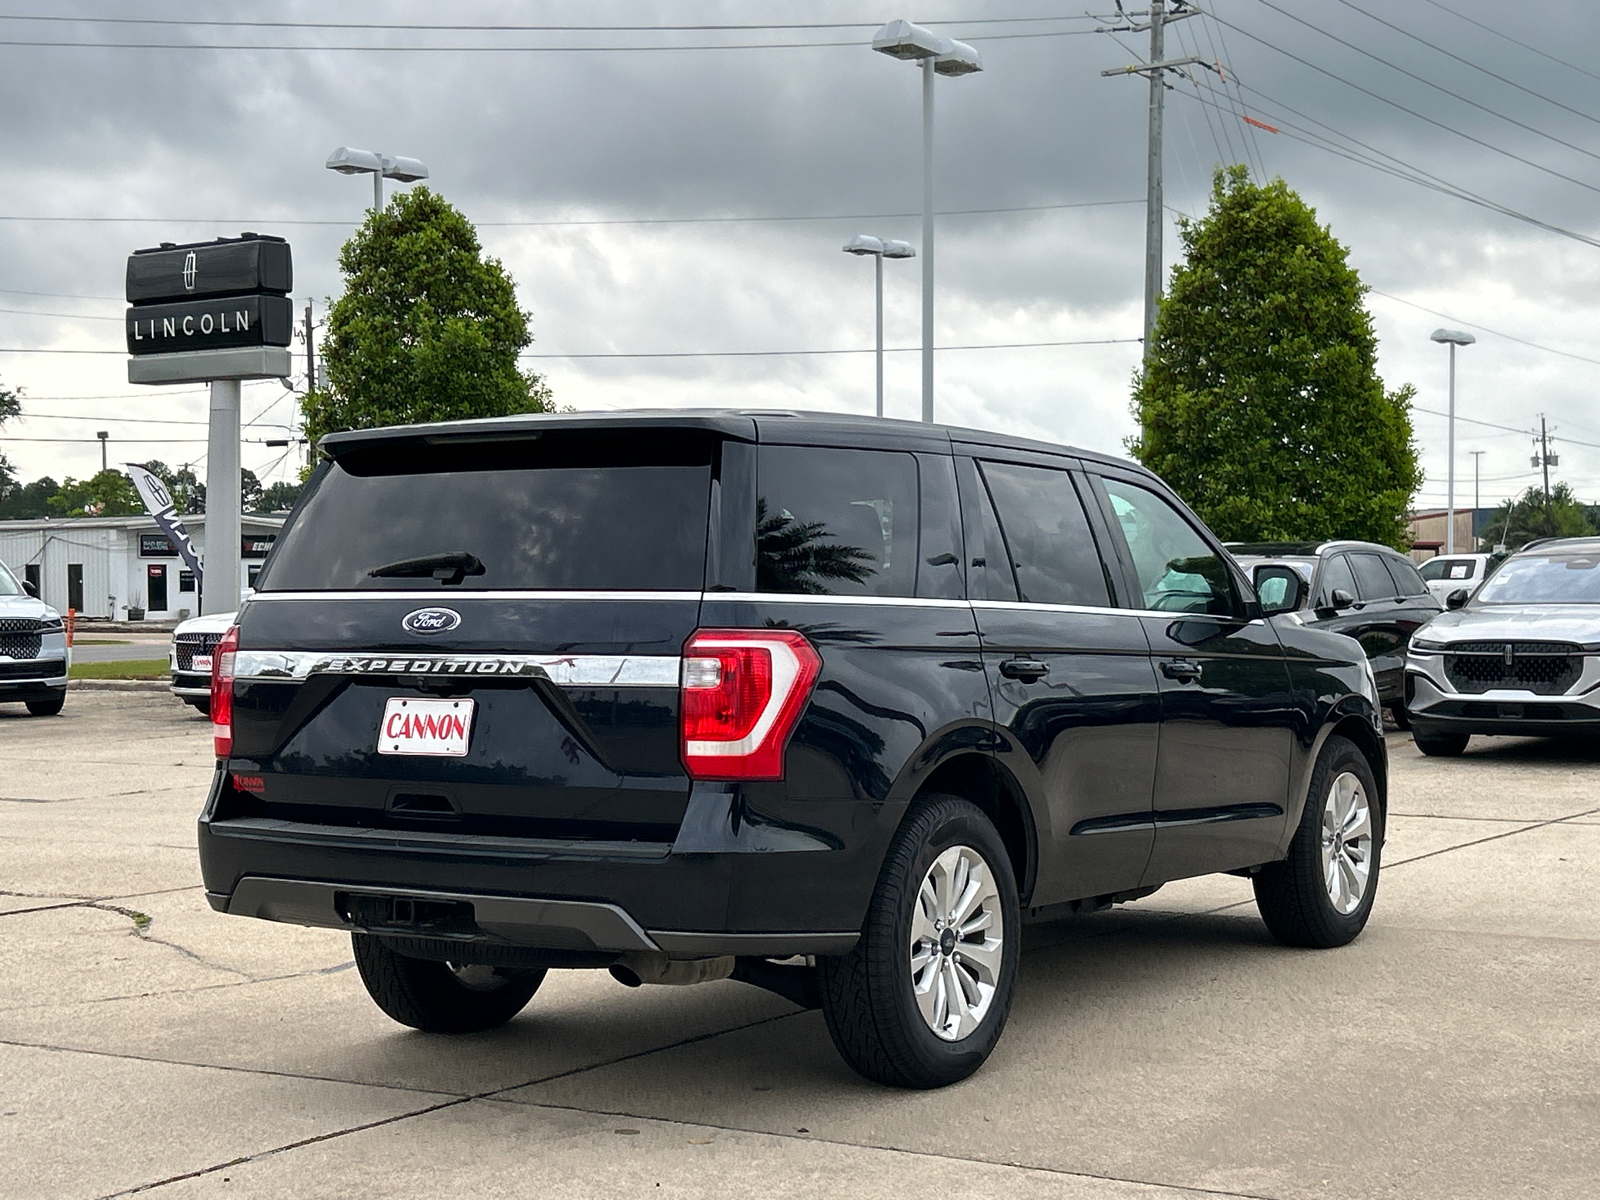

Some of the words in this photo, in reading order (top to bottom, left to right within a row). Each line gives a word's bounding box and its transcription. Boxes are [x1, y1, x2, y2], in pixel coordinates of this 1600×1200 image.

[134, 310, 249, 340] LINCOLN
[413, 612, 446, 628] Ford
[327, 658, 526, 673] EXPEDITION
[386, 712, 467, 740] CANNON
